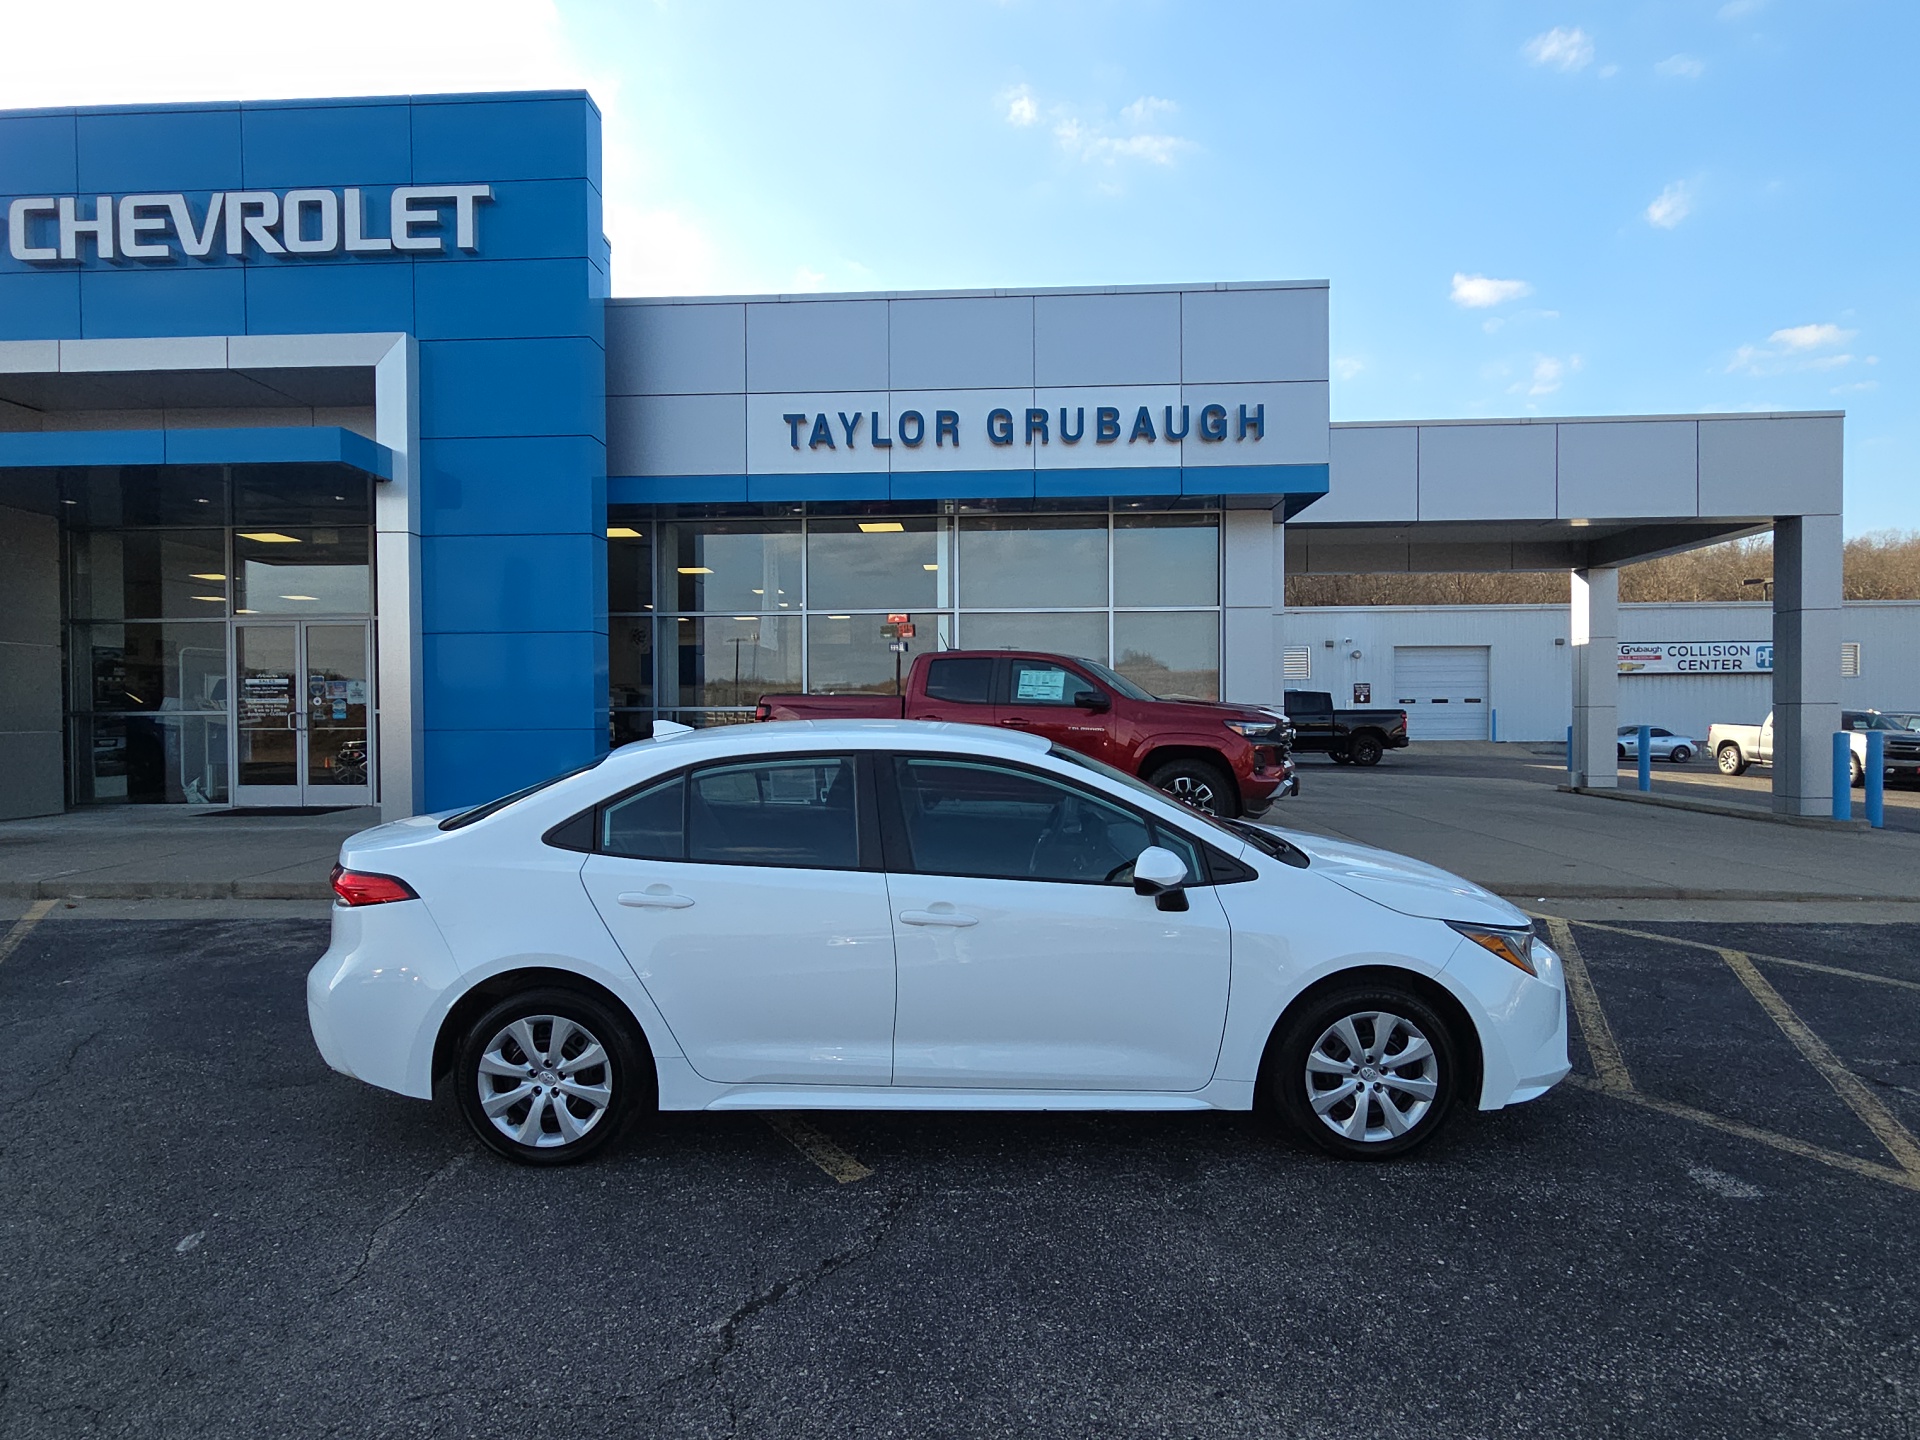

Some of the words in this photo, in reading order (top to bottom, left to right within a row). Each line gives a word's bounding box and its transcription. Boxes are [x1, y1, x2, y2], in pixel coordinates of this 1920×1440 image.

[8, 184, 495, 262] CHEVROLET
[783, 409, 960, 450] TAYLOR
[986, 403, 1266, 445] GRUBAUGH
[1621, 645, 1662, 654] Grubaugh
[1667, 645, 1750, 657] COLLISION
[1677, 660, 1743, 671] CENTER
